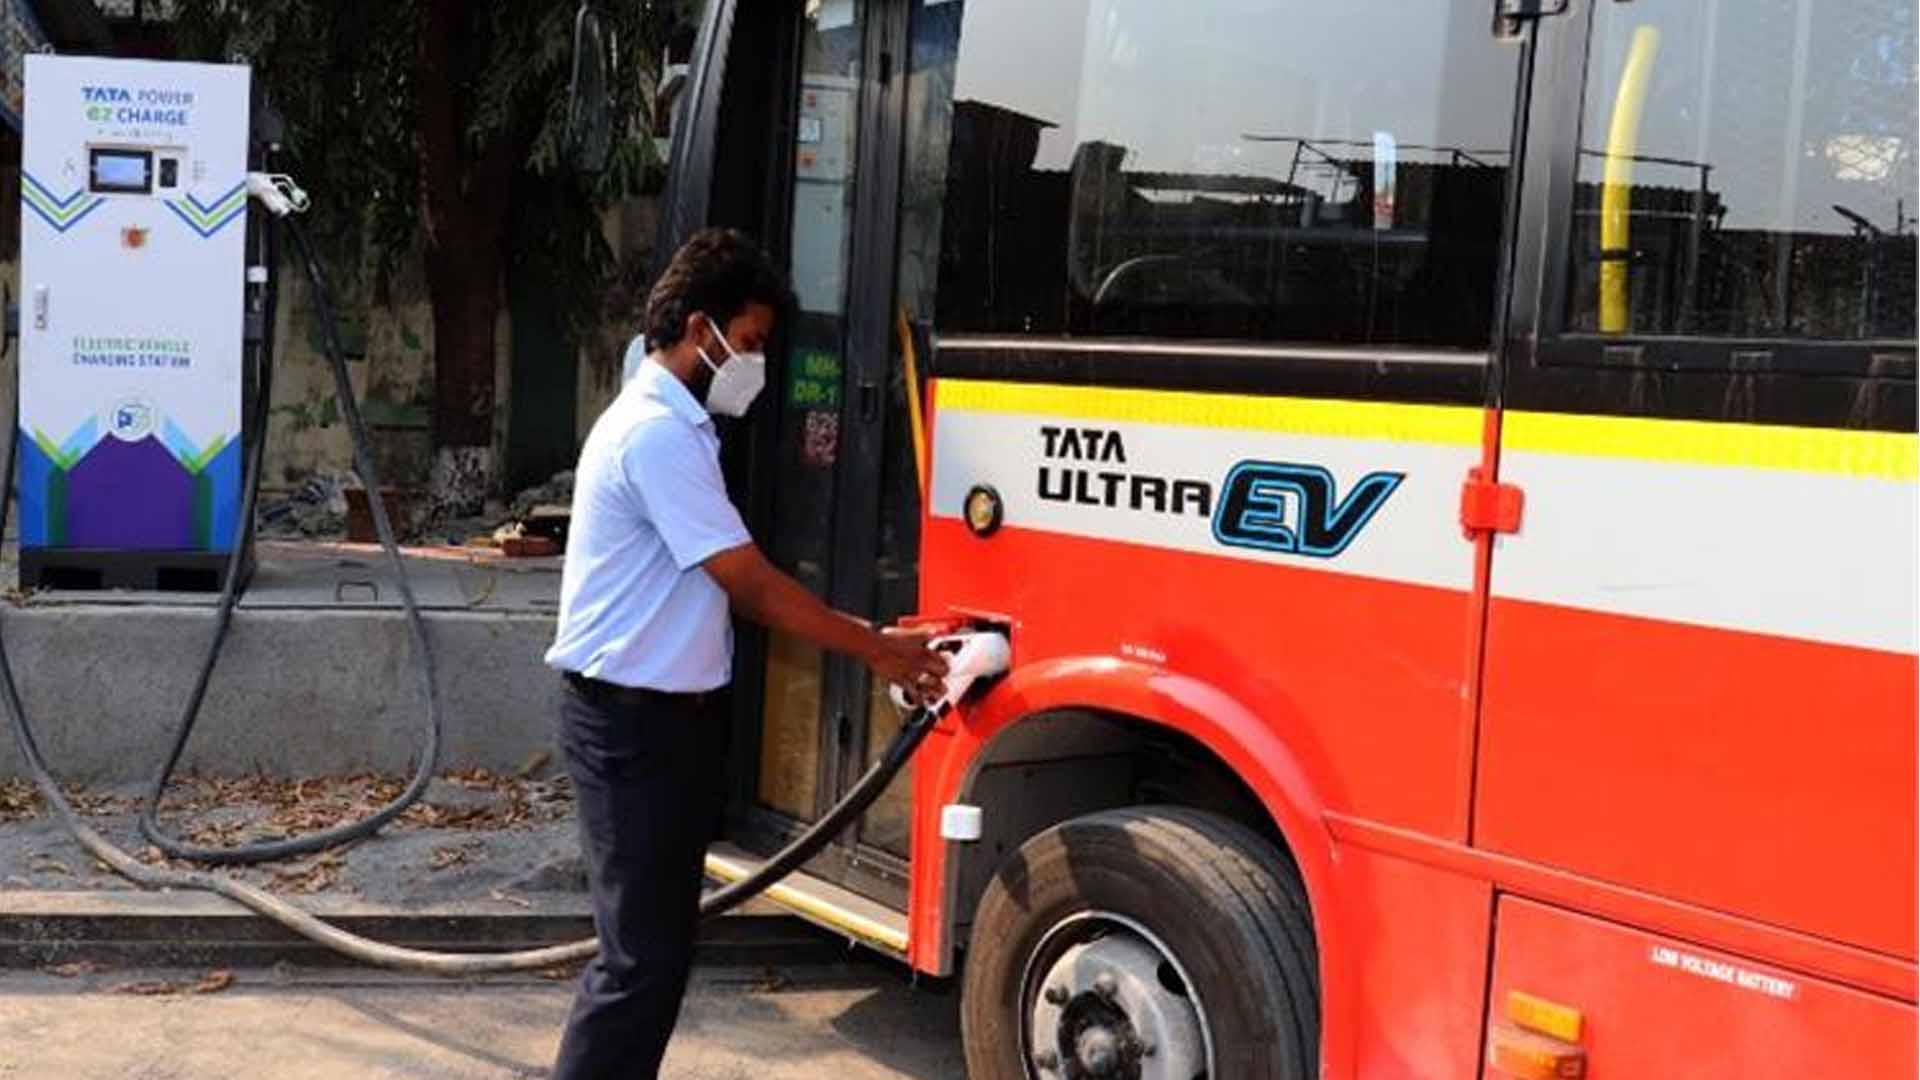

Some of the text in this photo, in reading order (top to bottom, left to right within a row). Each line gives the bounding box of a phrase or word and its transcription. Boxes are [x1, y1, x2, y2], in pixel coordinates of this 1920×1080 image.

[82, 87, 194, 105] TATA POWER
[116, 107, 188, 126] CHARGE
[1040, 427, 1126, 463] TATA
[1037, 459, 1406, 558] ULTRA EV
